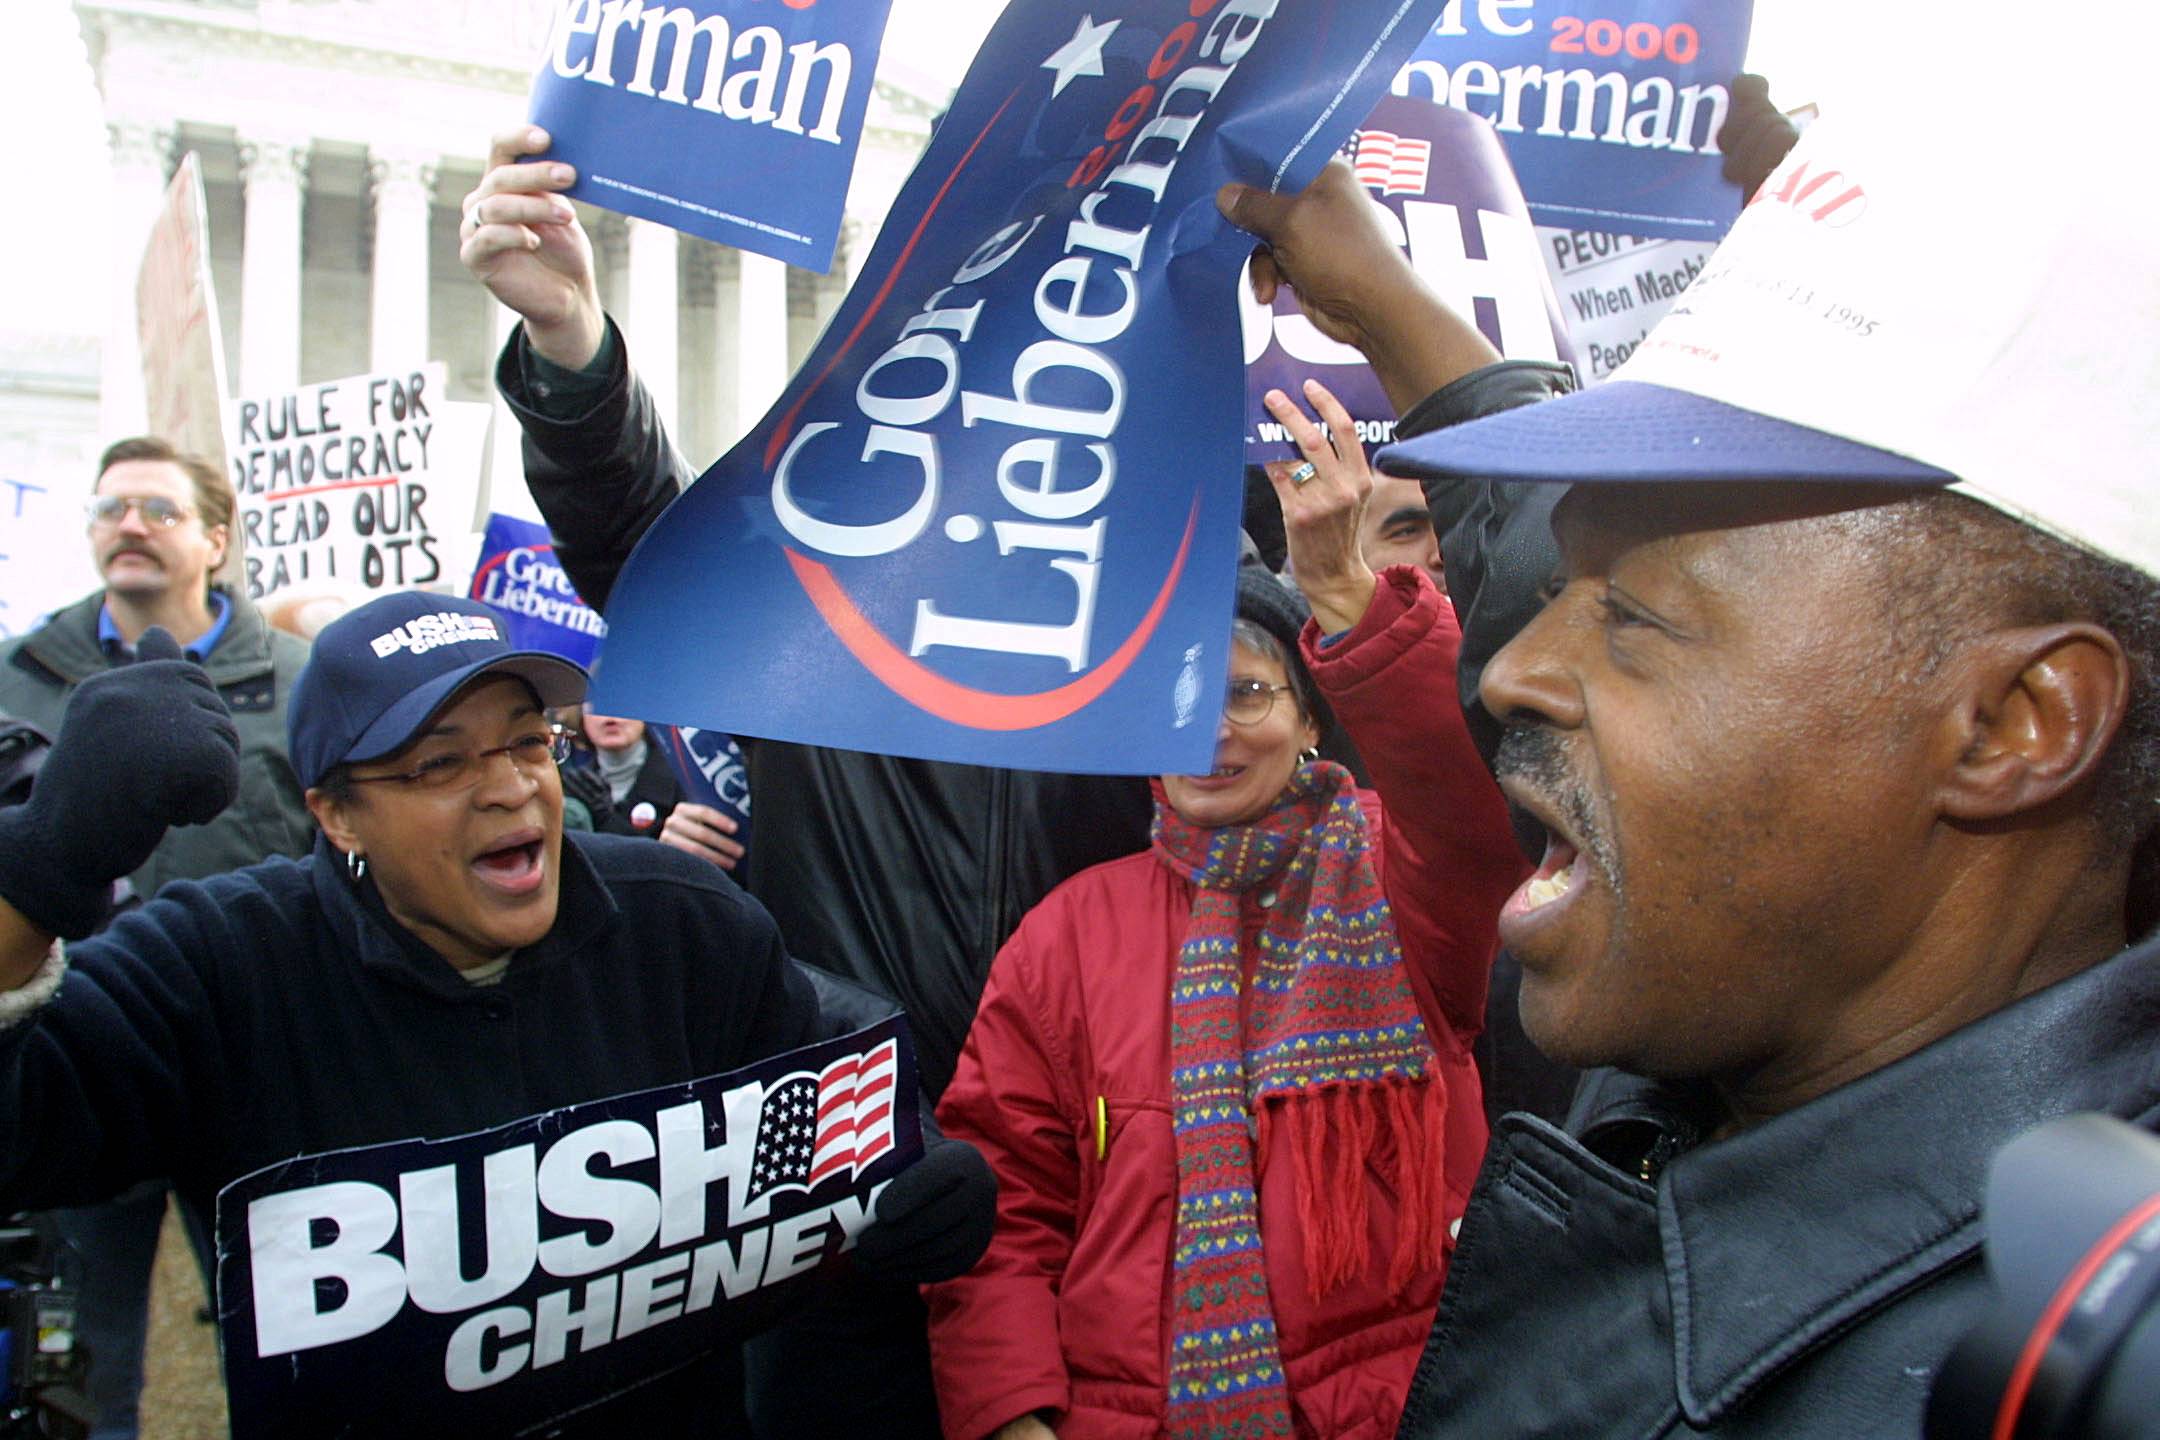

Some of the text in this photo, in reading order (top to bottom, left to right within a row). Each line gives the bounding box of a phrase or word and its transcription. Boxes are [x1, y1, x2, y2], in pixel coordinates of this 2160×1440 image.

[1550, 16, 1700, 64] 2000
[1300, 108, 1333, 148] COMMITTEE
[1330, 93, 1345, 112] AND
[1341, 50, 1376, 98] AUTHORIZED
[1570, 285, 1636, 322] When
[241, 370, 430, 446] RULE FOR
[771, 214, 1046, 557] Gore
[243, 483, 428, 549] READ OUR
[505, 546, 576, 597] Gore
[370, 611, 467, 659] BUSH
[247, 1080, 775, 1359] BUSH
[444, 1178, 895, 1393] CHENEY
